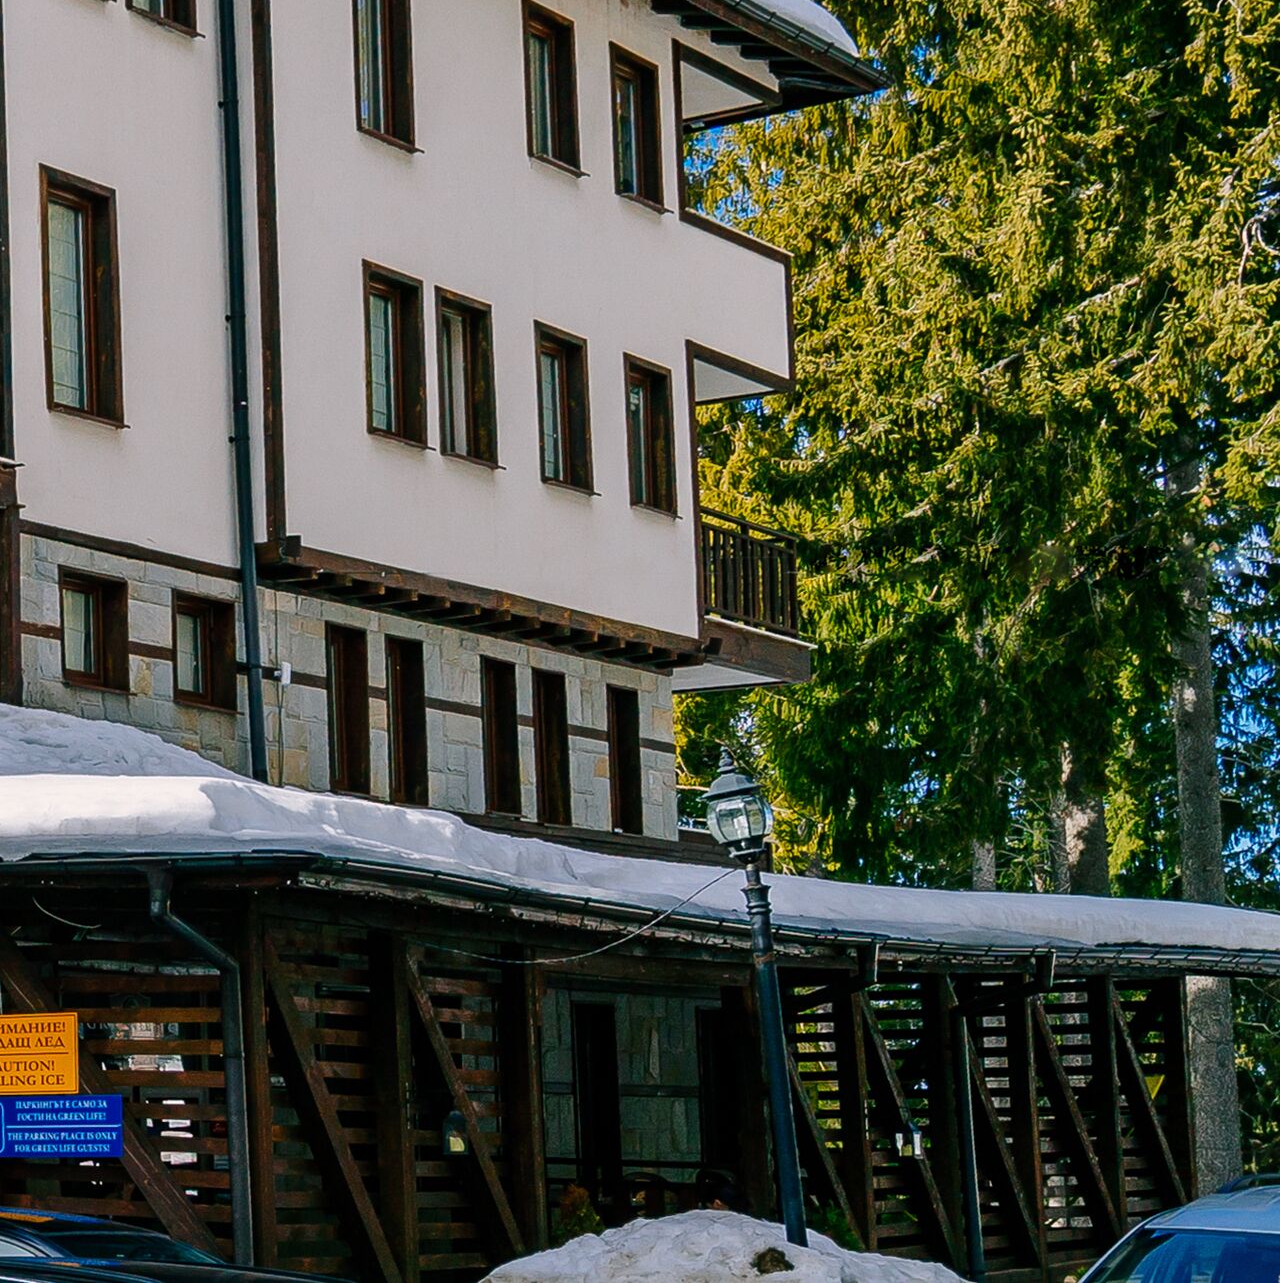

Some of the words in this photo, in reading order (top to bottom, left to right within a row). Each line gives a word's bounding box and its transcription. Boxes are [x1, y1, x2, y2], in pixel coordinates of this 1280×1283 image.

[35, 1036, 66, 1048] ЛЕД
[41, 1074, 65, 1085] ICE
[15, 1100, 65, 1109] ПАРКИНГЪТ
[72, 1099, 96, 1108] САМО
[97, 1099, 108, 1108] ЗА
[17, 1113, 44, 1121] ГОСТИ
[45, 1112, 57, 1121] НА
[58, 1112, 85, 1120] GREEN
[86, 1112, 107, 1120] LIFE!
[7, 1132, 24, 1140] THE
[25, 1132, 59, 1140] PARKING
[60, 1131, 85, 1140] PLACE
[86, 1131, 94, 1140] IS
[95, 1131, 118, 1140] ONLY
[14, 1144, 31, 1152] FOR
[31, 1144, 58, 1152] GREEN
[59, 1144, 76, 1152] LIFE
[77, 1144, 110, 1152] GUESTS!
